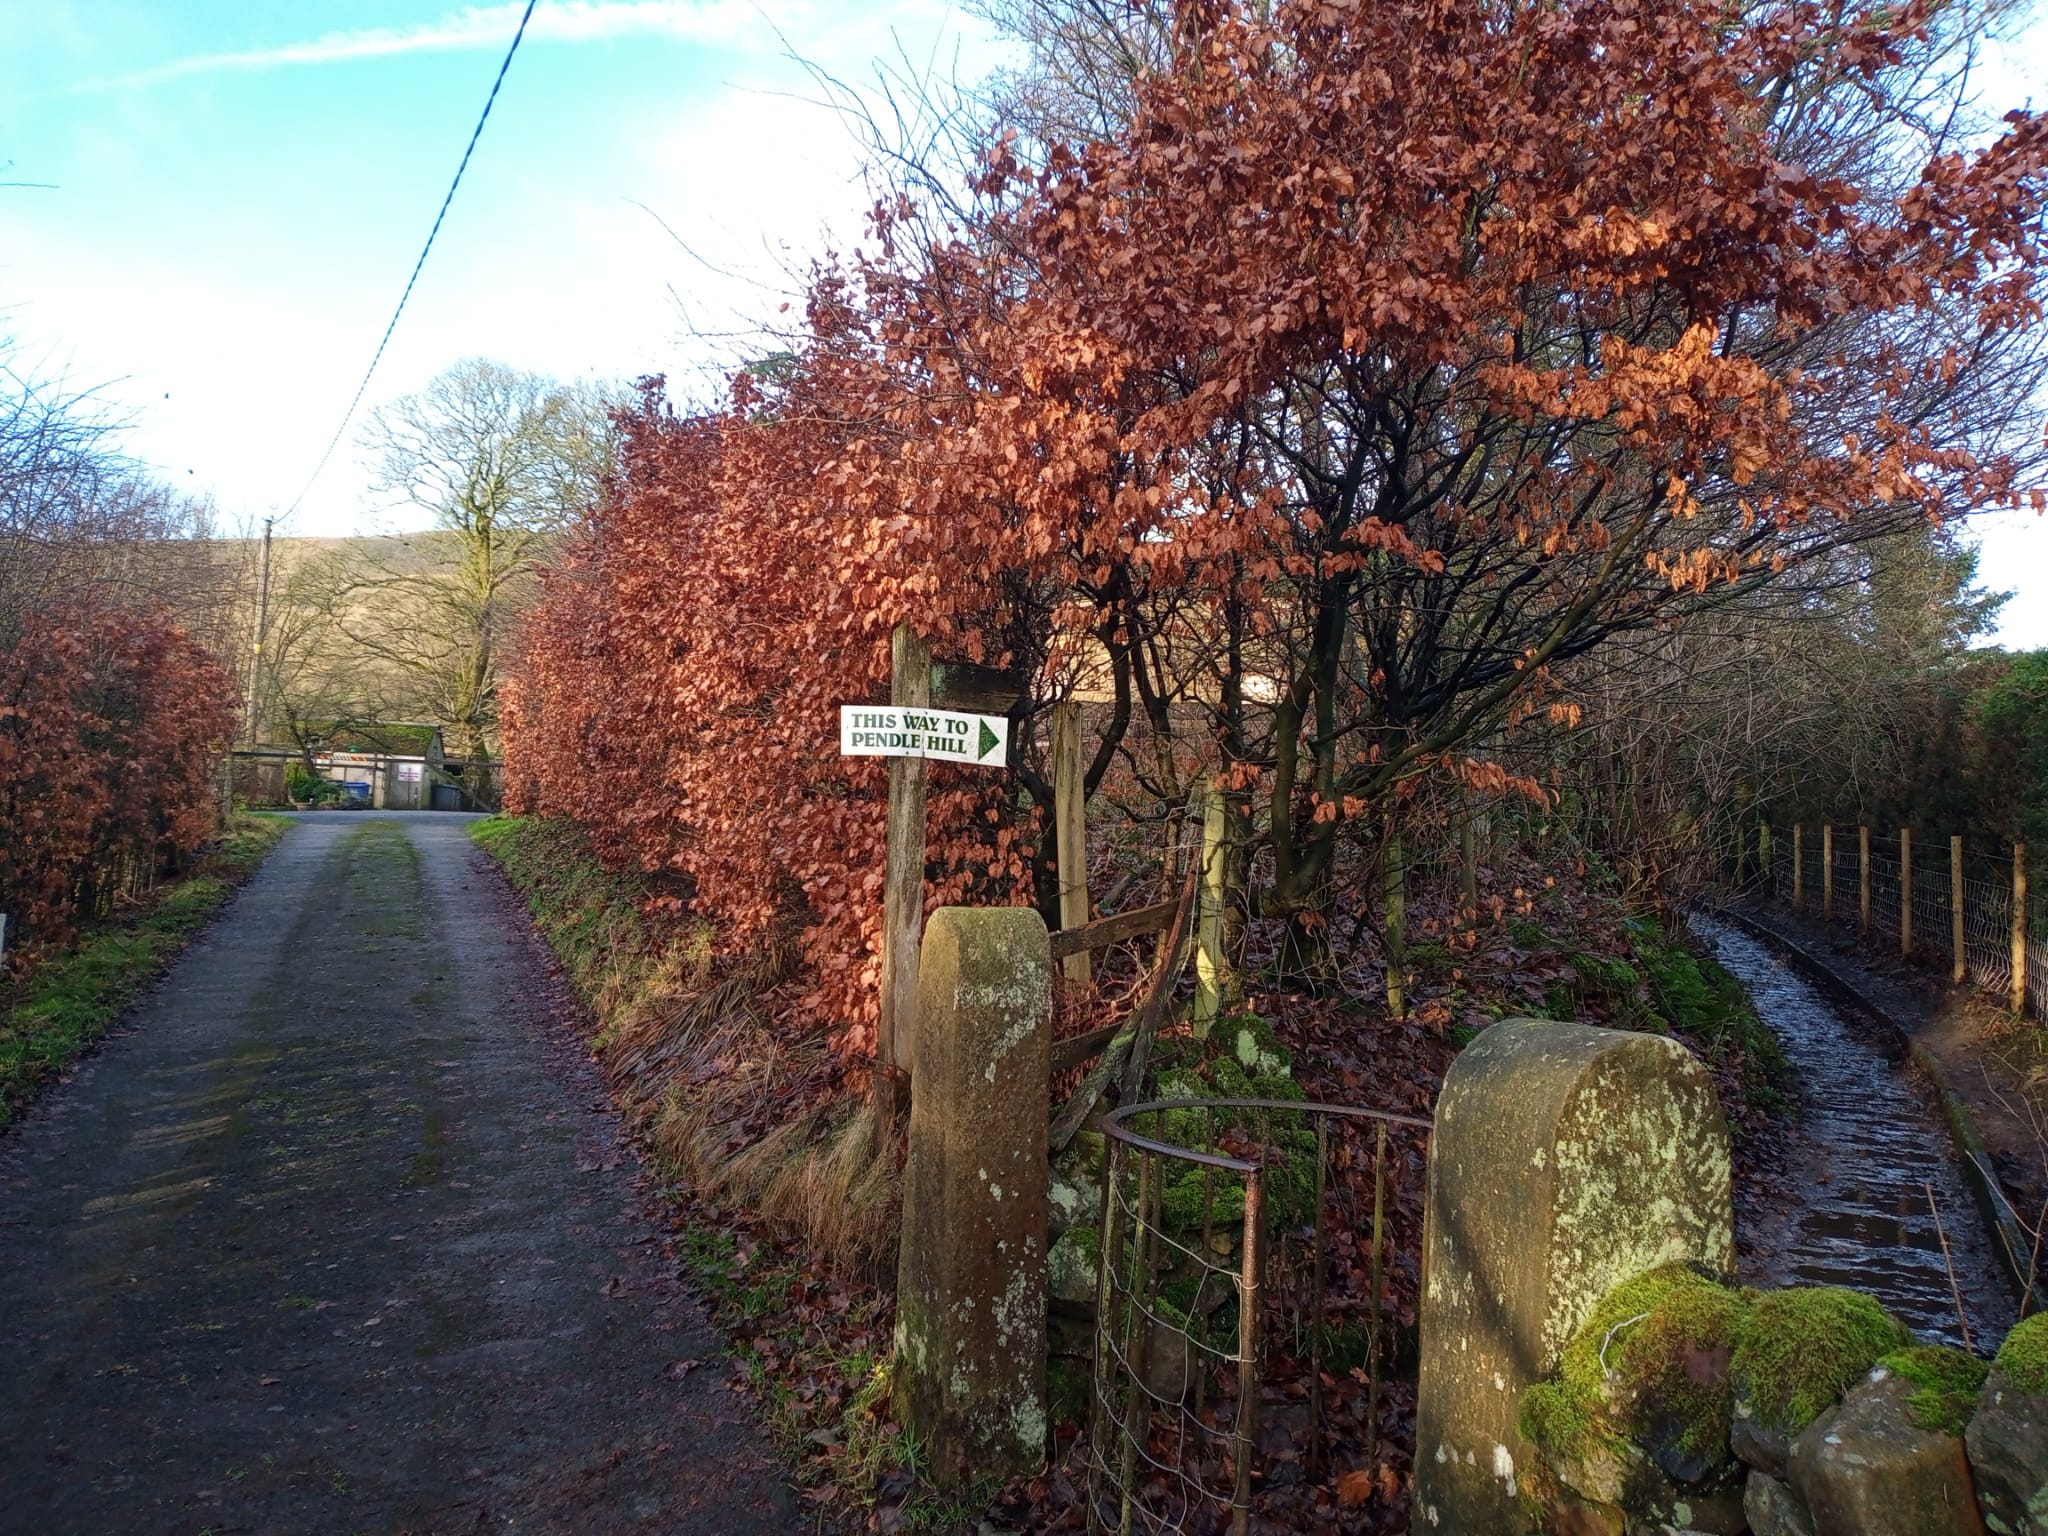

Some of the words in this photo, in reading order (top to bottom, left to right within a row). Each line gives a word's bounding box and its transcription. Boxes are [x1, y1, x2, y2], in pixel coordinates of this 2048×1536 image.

[852, 713, 897, 729] THIS
[903, 715, 940, 732] WAY
[945, 719, 969, 735] TO
[852, 733, 920, 748] PENDLE
[927, 736, 967, 754] HILL
